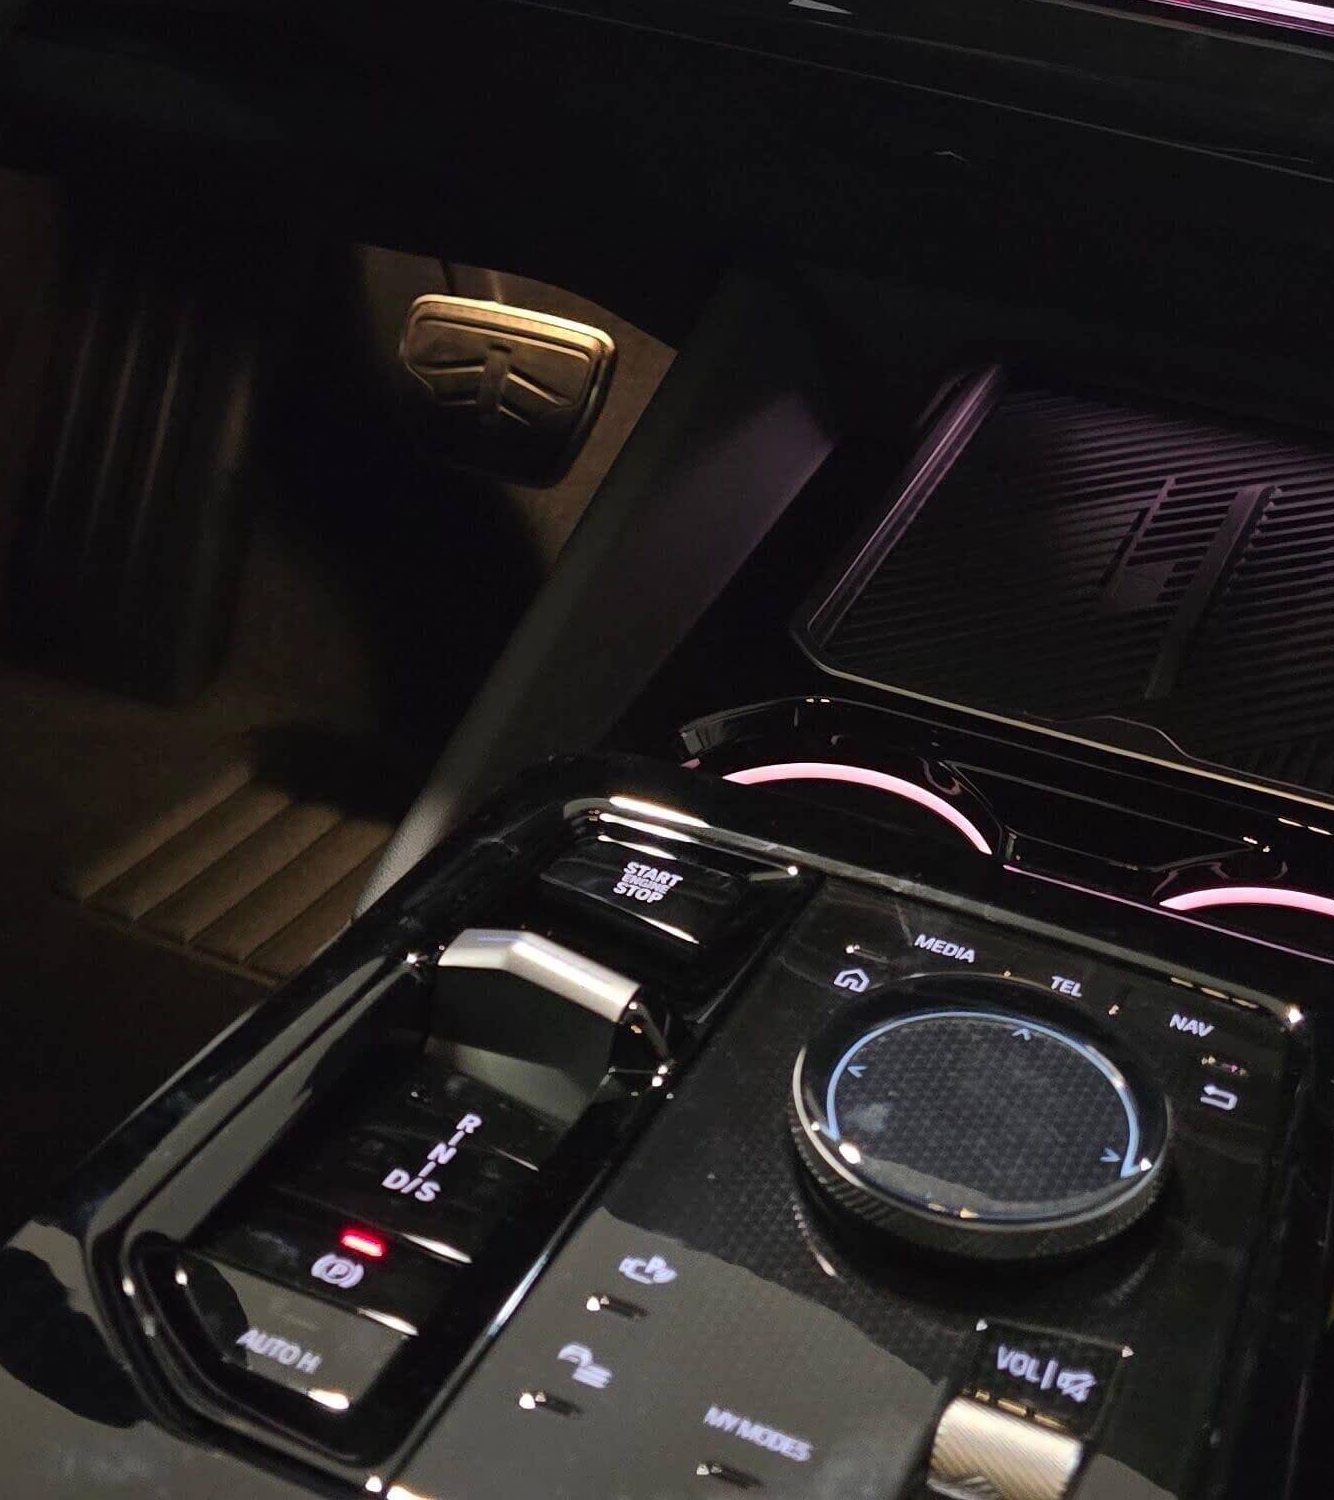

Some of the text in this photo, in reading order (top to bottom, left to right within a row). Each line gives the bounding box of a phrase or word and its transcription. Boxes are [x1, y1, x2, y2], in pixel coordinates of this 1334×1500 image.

[623, 861, 684, 888] START
[613, 881, 665, 903] STOP
[914, 934, 975, 964] MEDIA
[1051, 976, 1083, 998] TEL
[1169, 1013, 1214, 1037] NAV
[455, 1113, 483, 1134] R
[427, 1142, 457, 1165] N
[381, 1168, 441, 1202] D/S
[235, 1327, 324, 1375] AUTO H
[996, 1344, 1040, 1384] VOL
